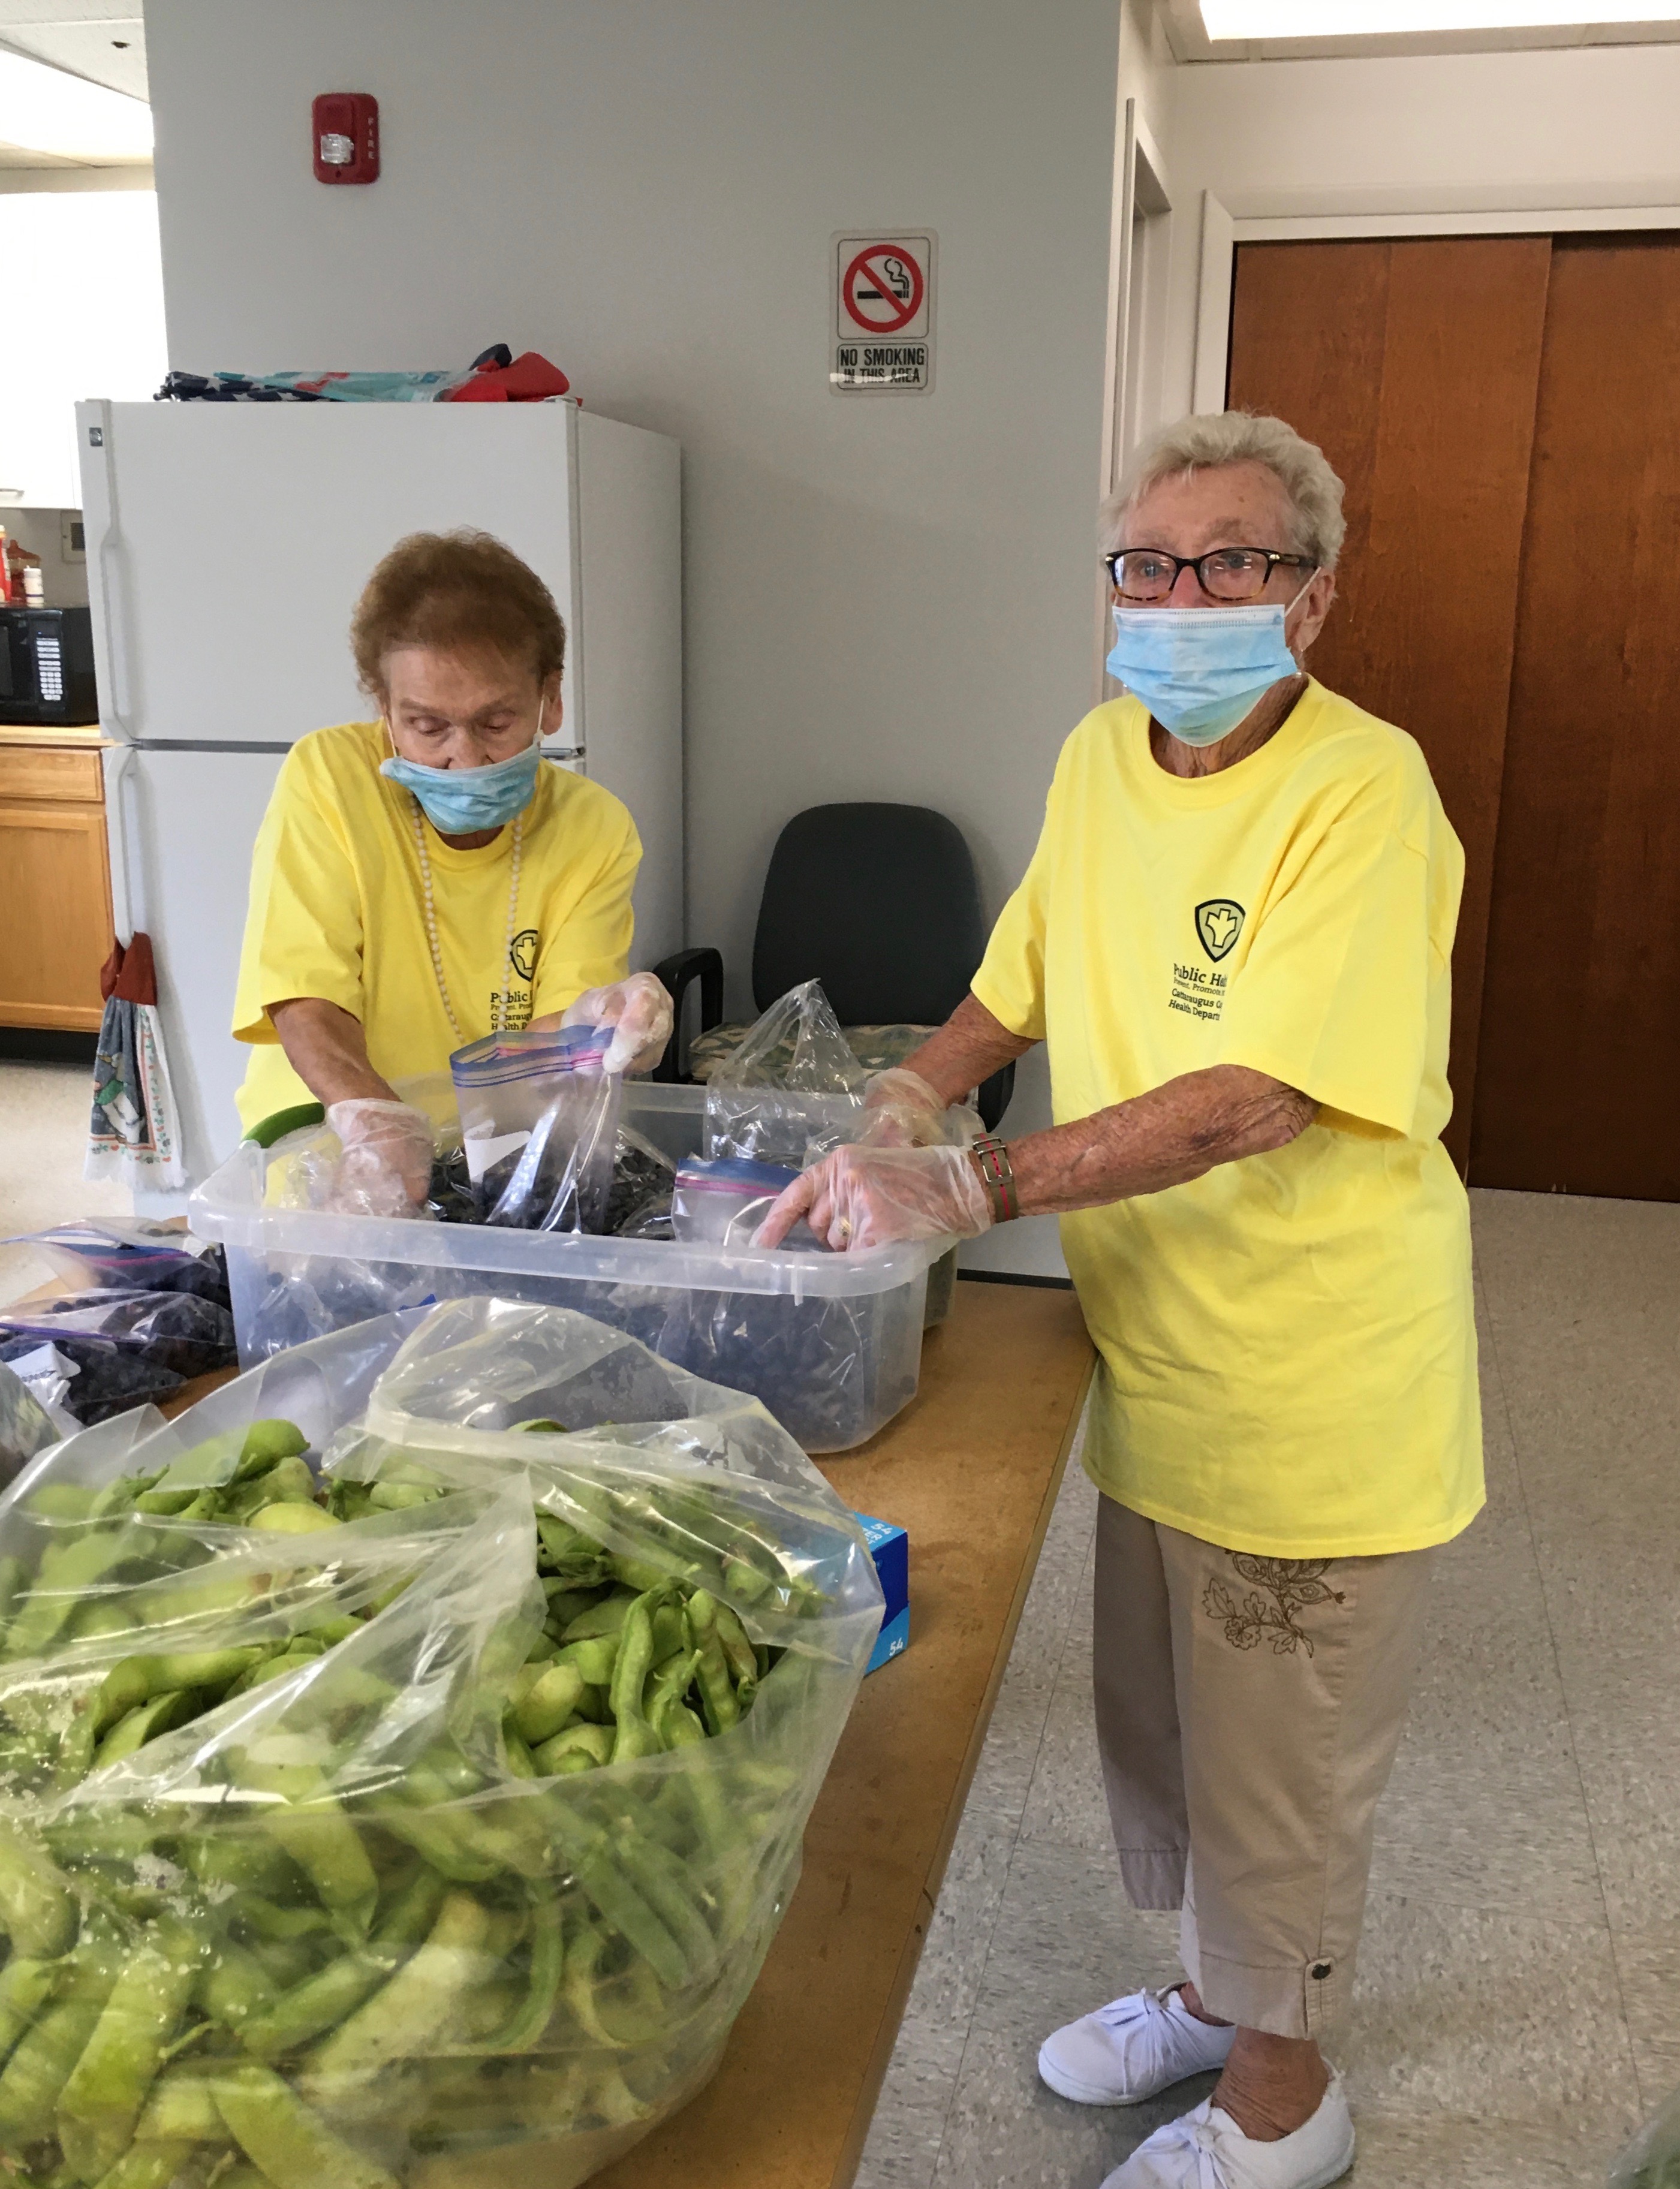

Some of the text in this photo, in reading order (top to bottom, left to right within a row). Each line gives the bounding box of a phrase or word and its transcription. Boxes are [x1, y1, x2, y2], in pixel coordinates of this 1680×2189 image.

[840, 348, 924, 366] NO SMOKING
[890, 368, 920, 383] AREA
[1173, 963, 1206, 983] Public
[490, 990, 528, 1002] Pblic
[871, 1523, 893, 1534] 54
[889, 1637, 903, 1656] 54
